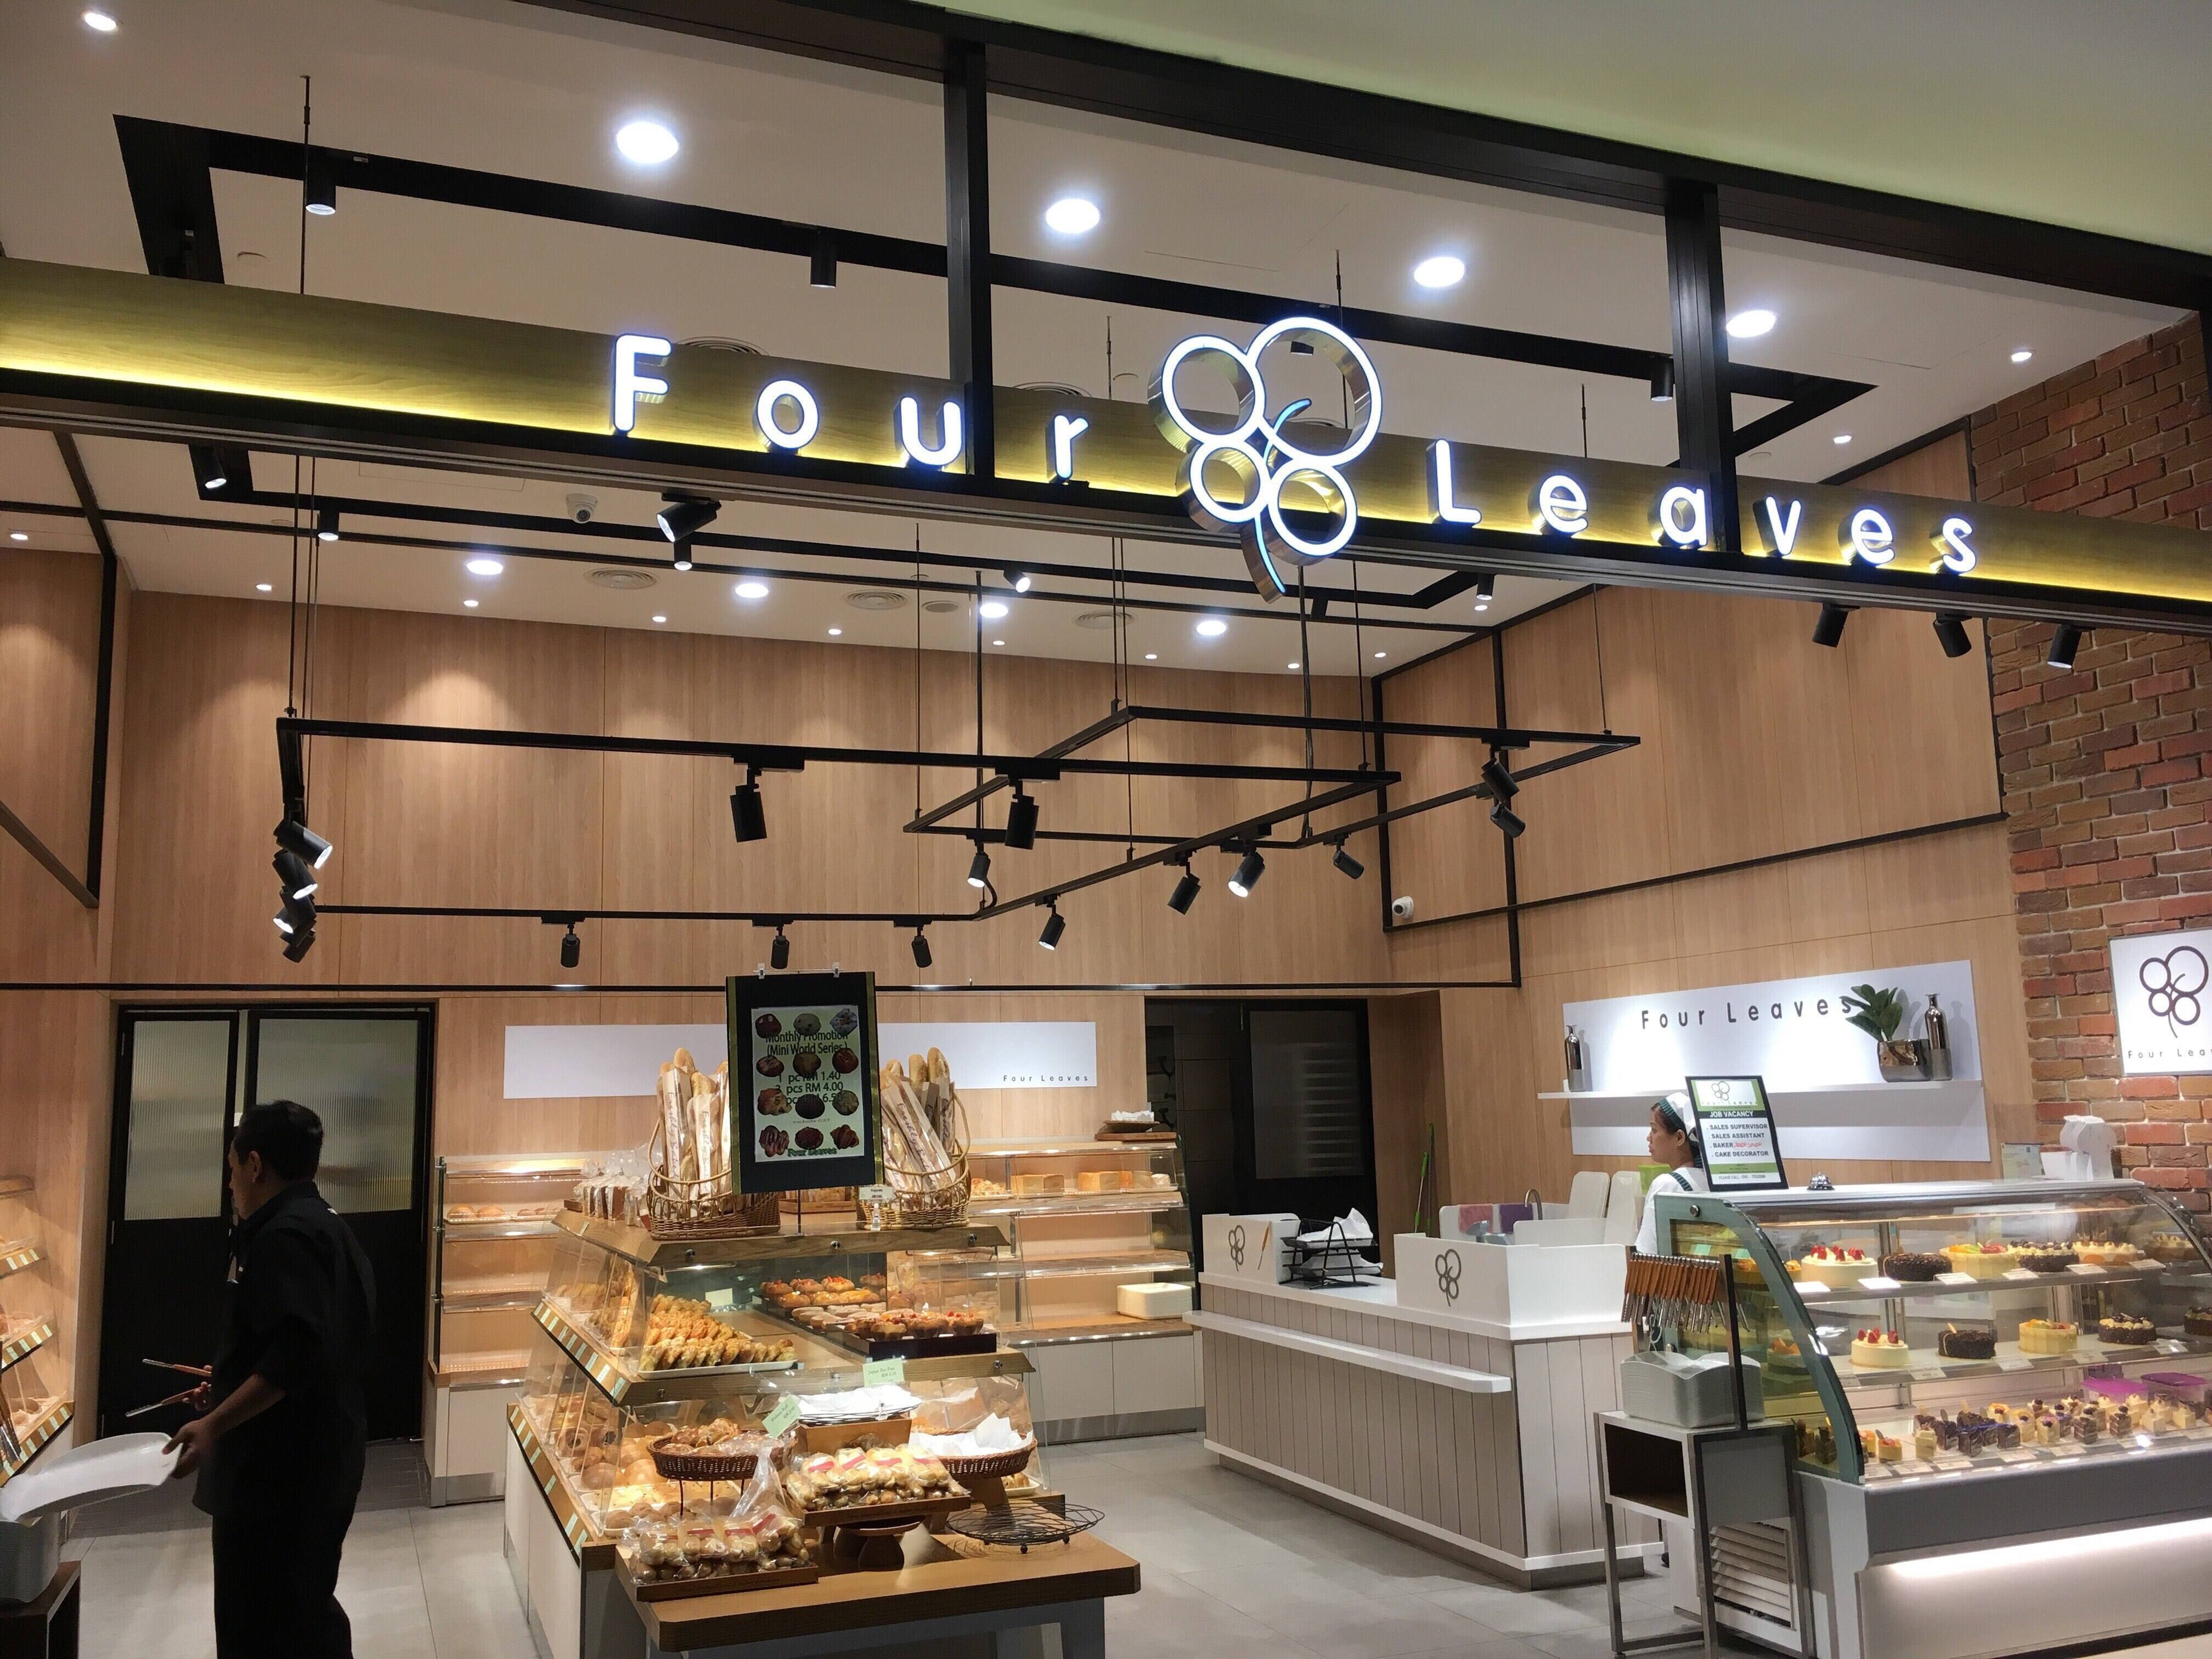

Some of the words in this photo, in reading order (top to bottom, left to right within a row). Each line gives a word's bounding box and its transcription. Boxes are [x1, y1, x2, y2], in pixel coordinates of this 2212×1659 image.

[611, 332, 1090, 479] Four
[1432, 438, 1977, 574] Leaves
[1641, 1009, 1705, 1030] Four
[1727, 998, 1852, 1023] Leaves
[767, 1044, 789, 1056] (Mini
[791, 1043, 816, 1055] World
[2128, 1051, 2163, 1059] Four
[2177, 1048, 2212, 1057] Lea
[788, 1075, 800, 1085] pc
[821, 1071, 840, 1080] 1.40
[786, 1085, 803, 1096] pcs
[805, 1082, 821, 1092] RM
[823, 1081, 843, 1091] 4.00
